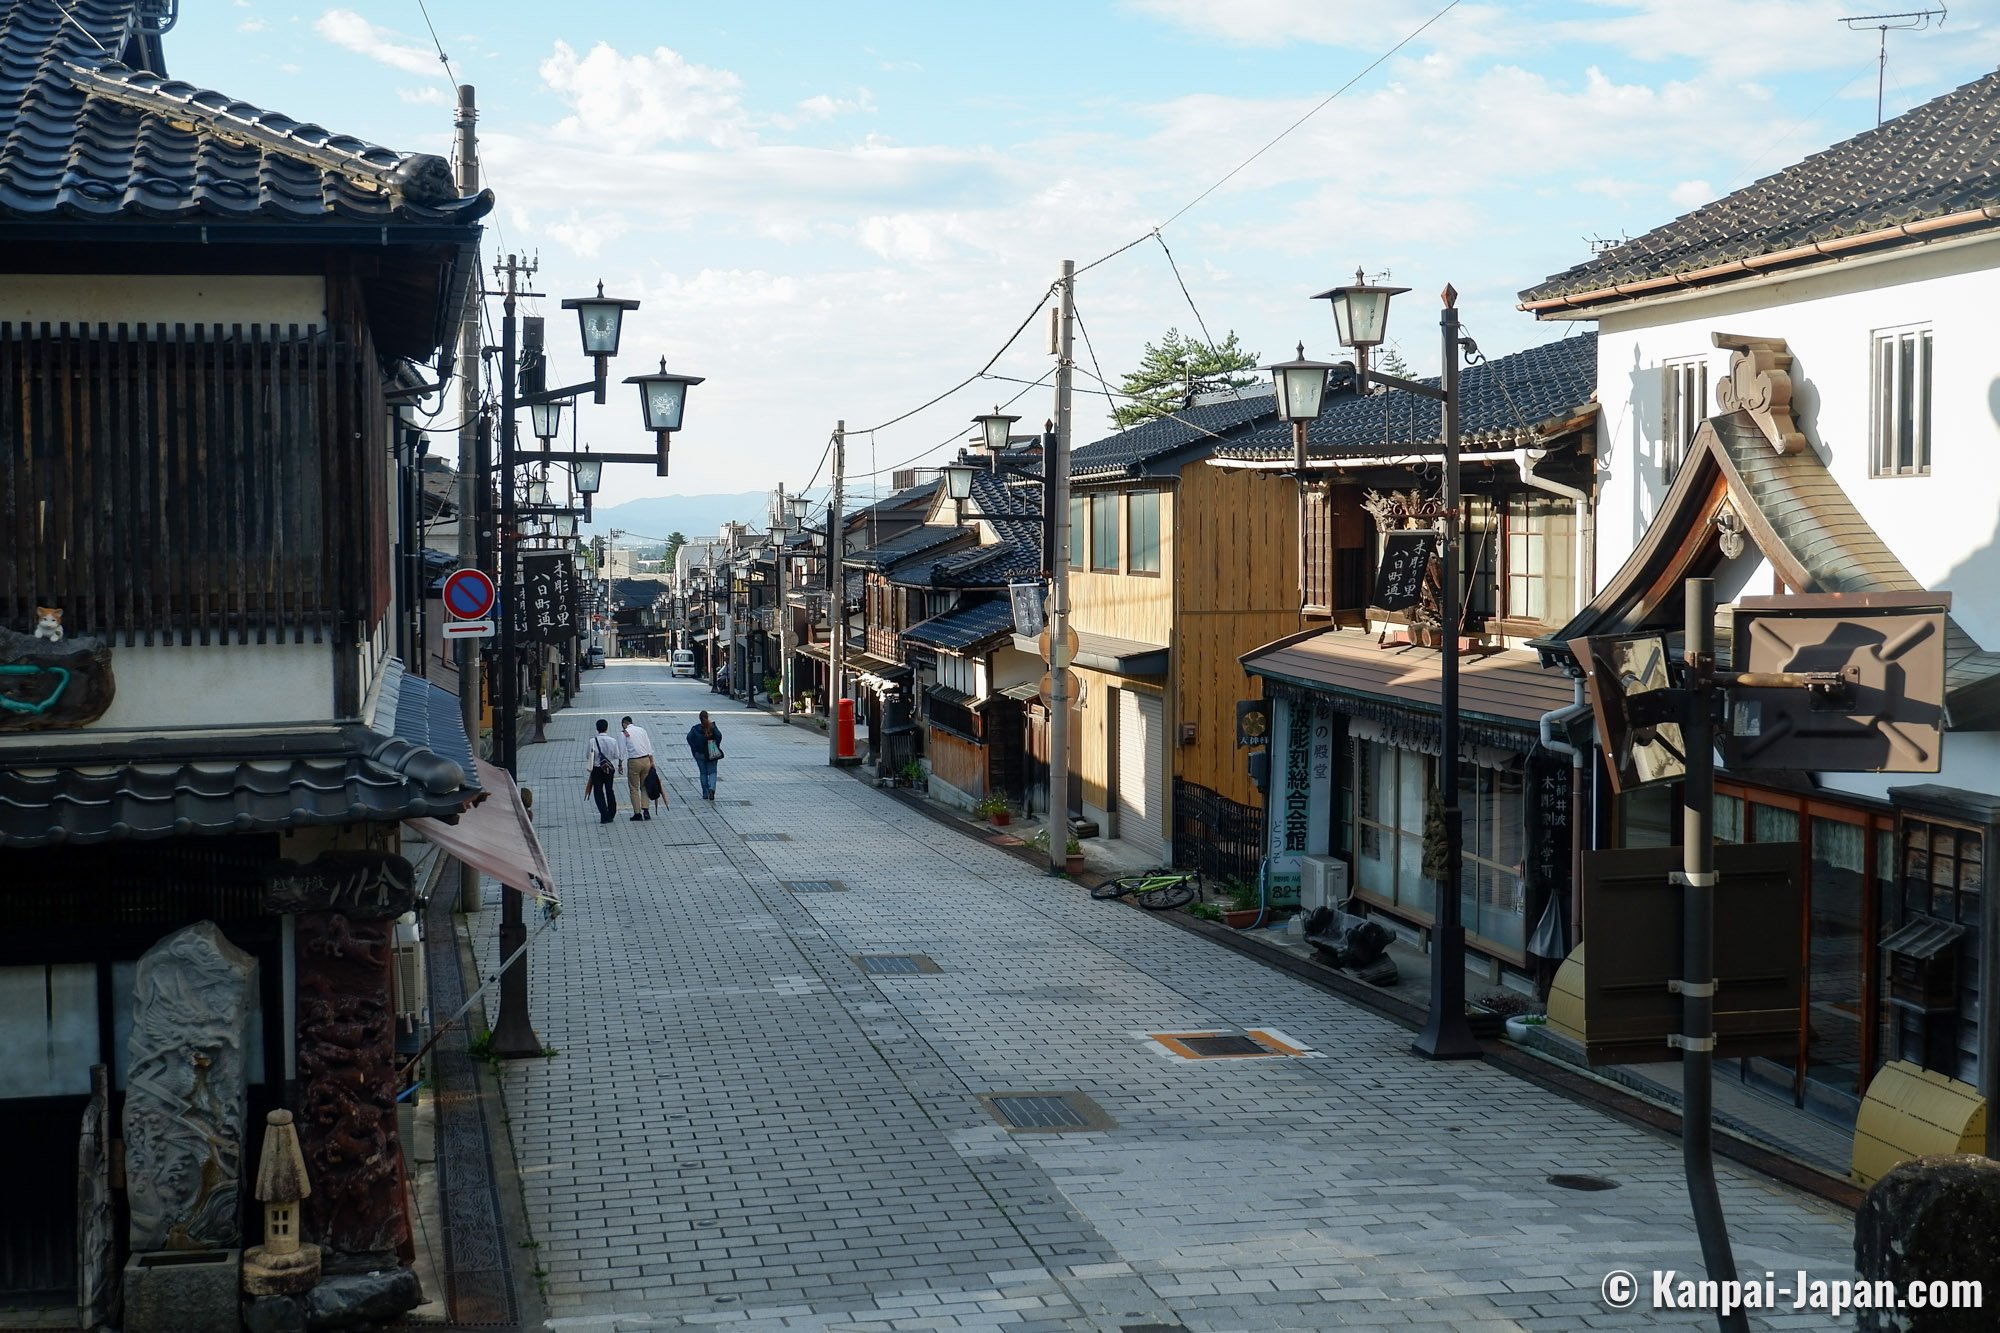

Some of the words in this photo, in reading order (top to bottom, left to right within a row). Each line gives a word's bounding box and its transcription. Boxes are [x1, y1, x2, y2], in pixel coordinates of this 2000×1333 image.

[554, 559, 570, 627] 木彫りの里
[1384, 550, 1409, 604] 八日町通り
[1402, 538, 1427, 597] 木彫りの里
[532, 573, 556, 636] 八日町通り
[1272, 820, 1283, 864] どうぞ
